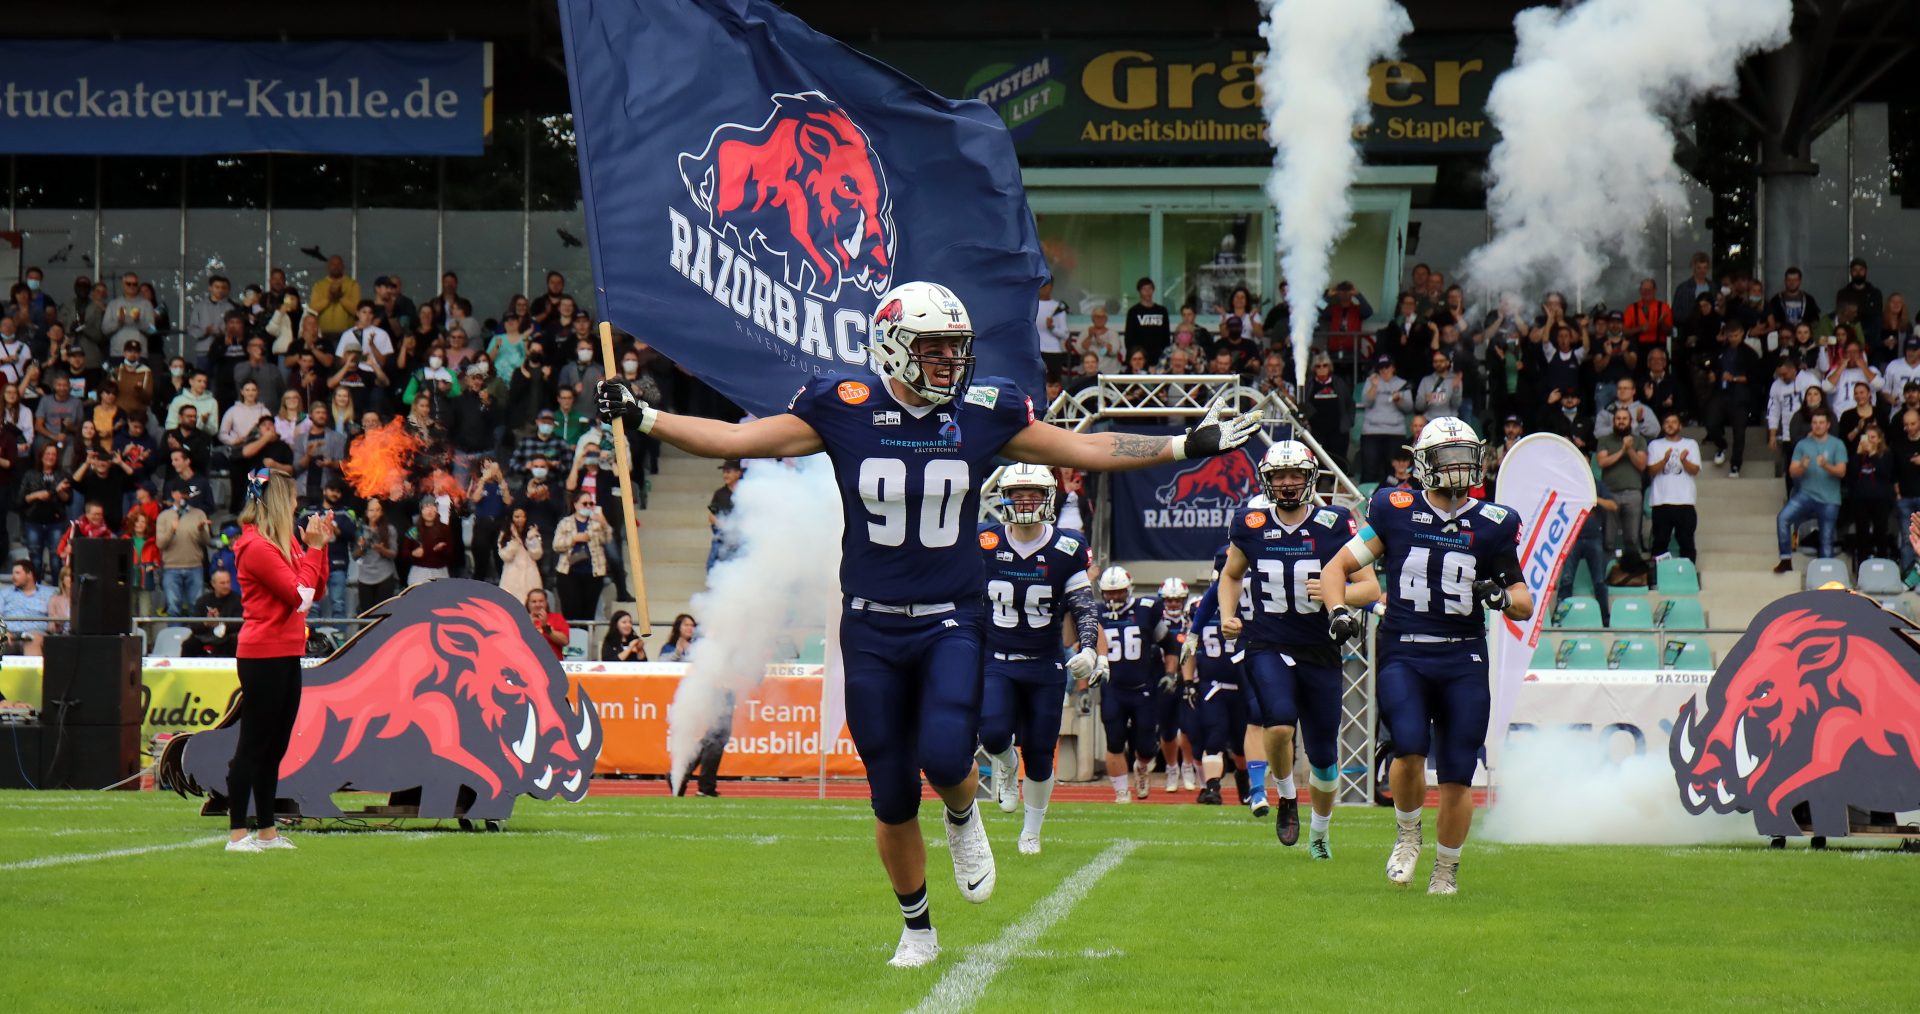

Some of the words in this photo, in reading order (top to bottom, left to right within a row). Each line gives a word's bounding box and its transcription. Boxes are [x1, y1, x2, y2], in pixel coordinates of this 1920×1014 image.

[0, 77, 458, 118] tuckateur-Kuhle.de
[979, 57, 1050, 104] SYSTEM
[1082, 51, 1483, 110] Gräer
[1012, 87, 1051, 121] LIFT
[1387, 116, 1485, 143] Stapler
[1137, 314, 1163, 327] VANS
[880, 438, 948, 448] SCHREZENMAIER
[858, 457, 970, 548] 90
[1144, 508, 1235, 528] RAZORBA
[1528, 500, 1570, 607] cher
[1400, 546, 1478, 617] 49
[1106, 625, 1143, 663] 56
[1655, 673, 1714, 684] RAZORB
[633, 696, 657, 720] in
[744, 699, 816, 722] Team
